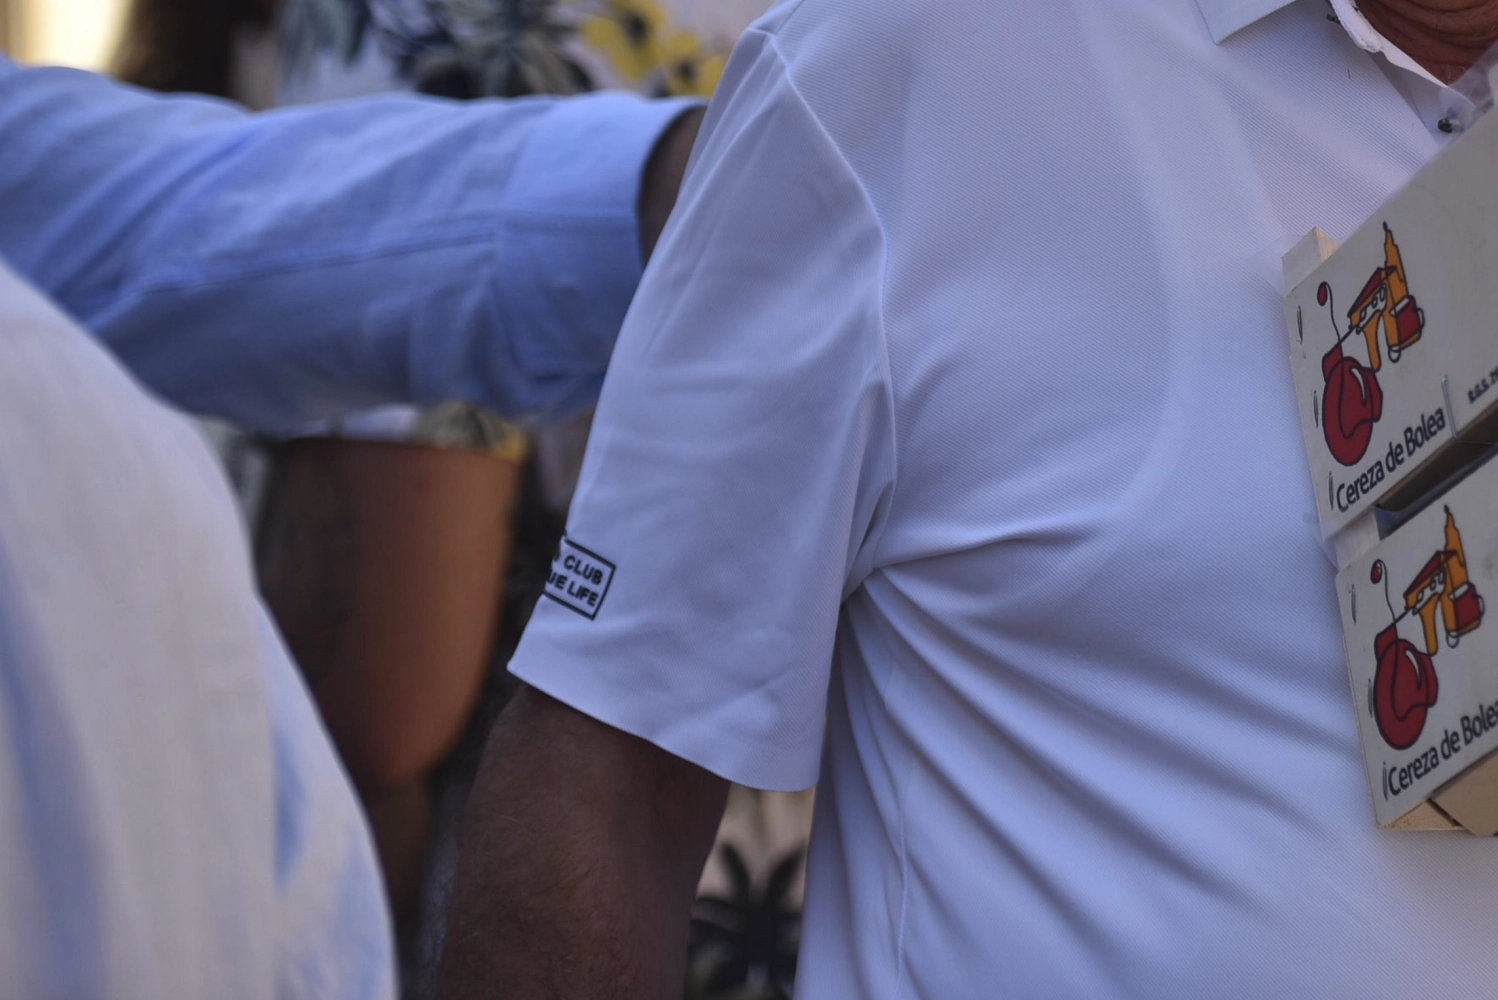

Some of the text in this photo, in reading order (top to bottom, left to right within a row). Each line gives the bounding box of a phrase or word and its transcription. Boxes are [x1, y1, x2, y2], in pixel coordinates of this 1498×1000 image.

[1336, 407, 1446, 513] Cereza de Bolea
[563, 555, 603, 585] CLUB
[567, 581, 599, 608] LIFE
[1388, 746, 1440, 796] Cereza
[1441, 729, 1461, 760] de
